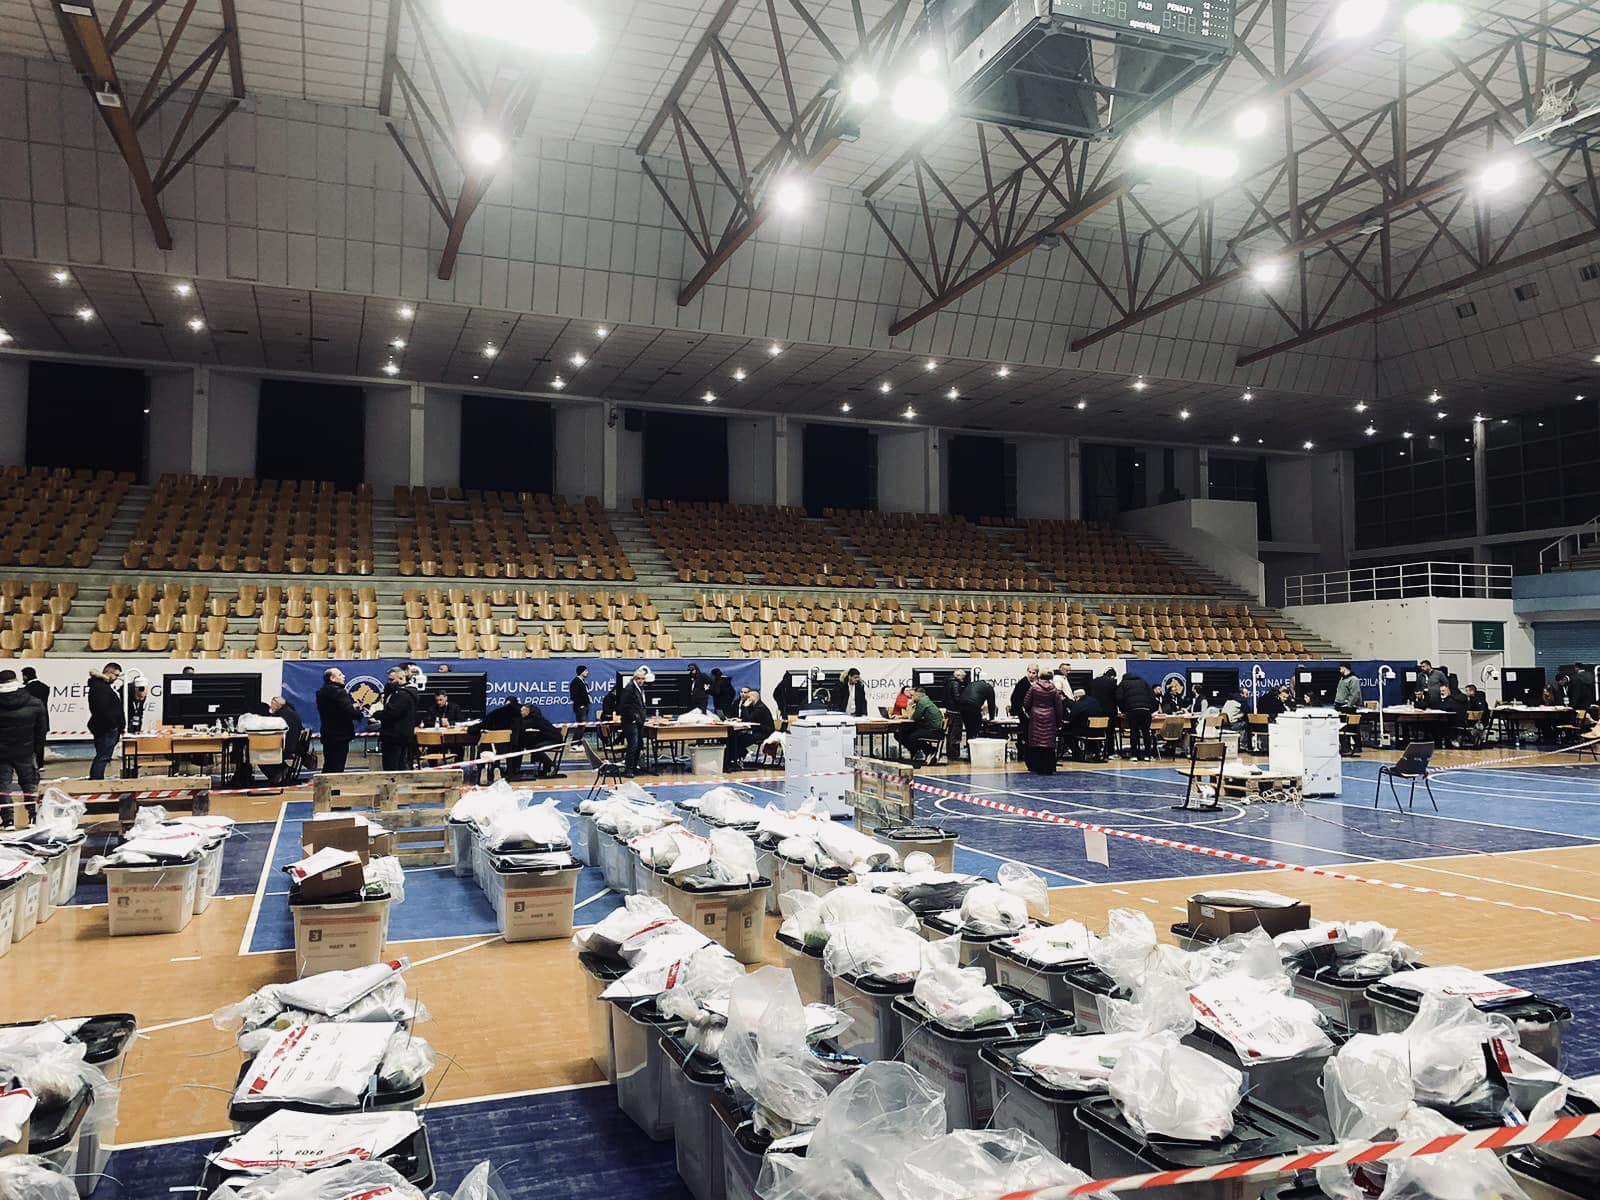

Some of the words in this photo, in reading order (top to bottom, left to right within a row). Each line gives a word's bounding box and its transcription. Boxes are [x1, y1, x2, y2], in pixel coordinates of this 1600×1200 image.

[1166, 2, 1194, 15] PENALTY
[1203, 2, 1211, 10] 12
[486, 681, 557, 693] OMUNALE
[561, 681, 570, 692] E
[863, 679, 895, 689] NDRA
